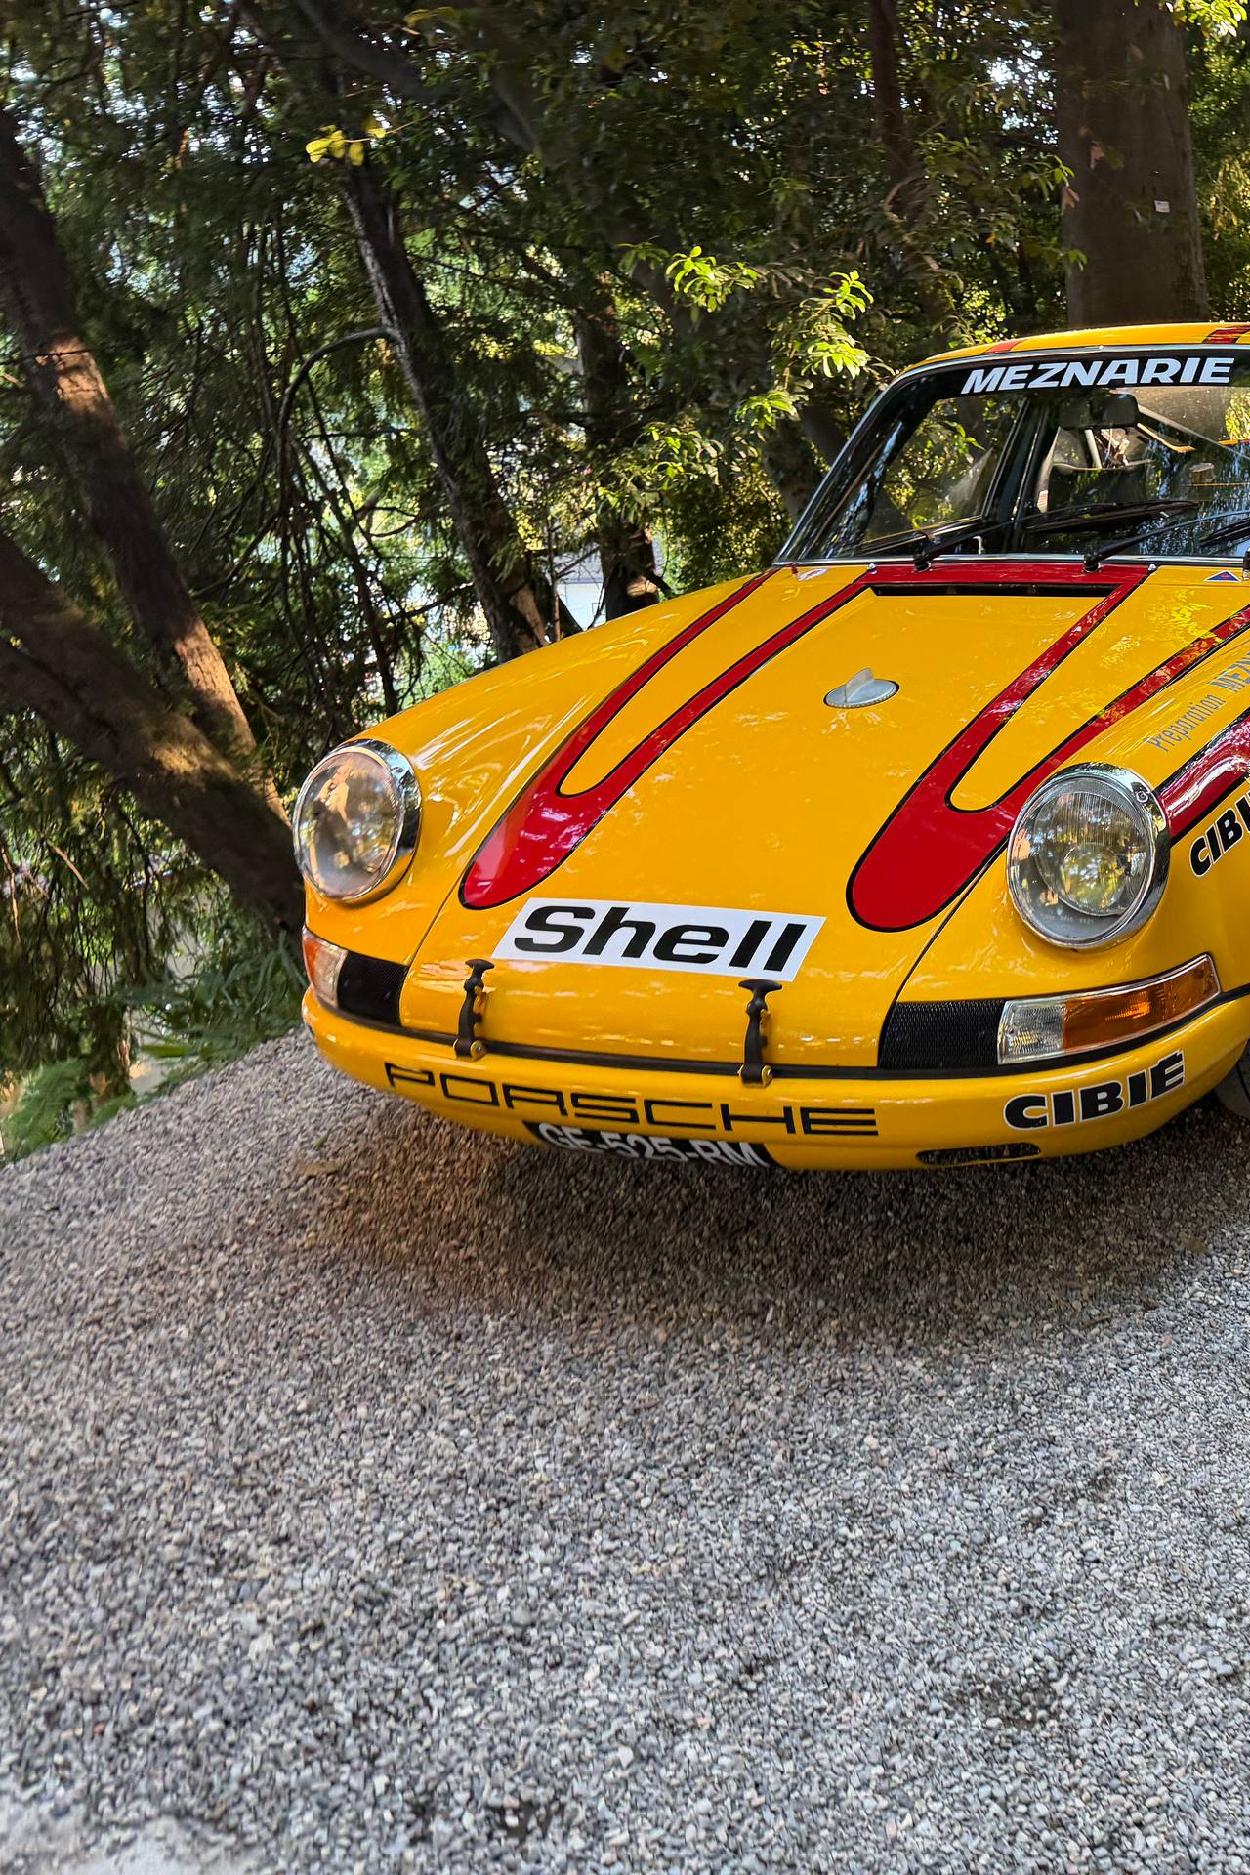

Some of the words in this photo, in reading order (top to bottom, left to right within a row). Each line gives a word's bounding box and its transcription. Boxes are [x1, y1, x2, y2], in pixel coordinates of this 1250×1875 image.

[961, 357, 1234, 395] MEZNARIE
[514, 905, 807, 972] Shell
[385, 1062, 879, 1137] PORSCHE
